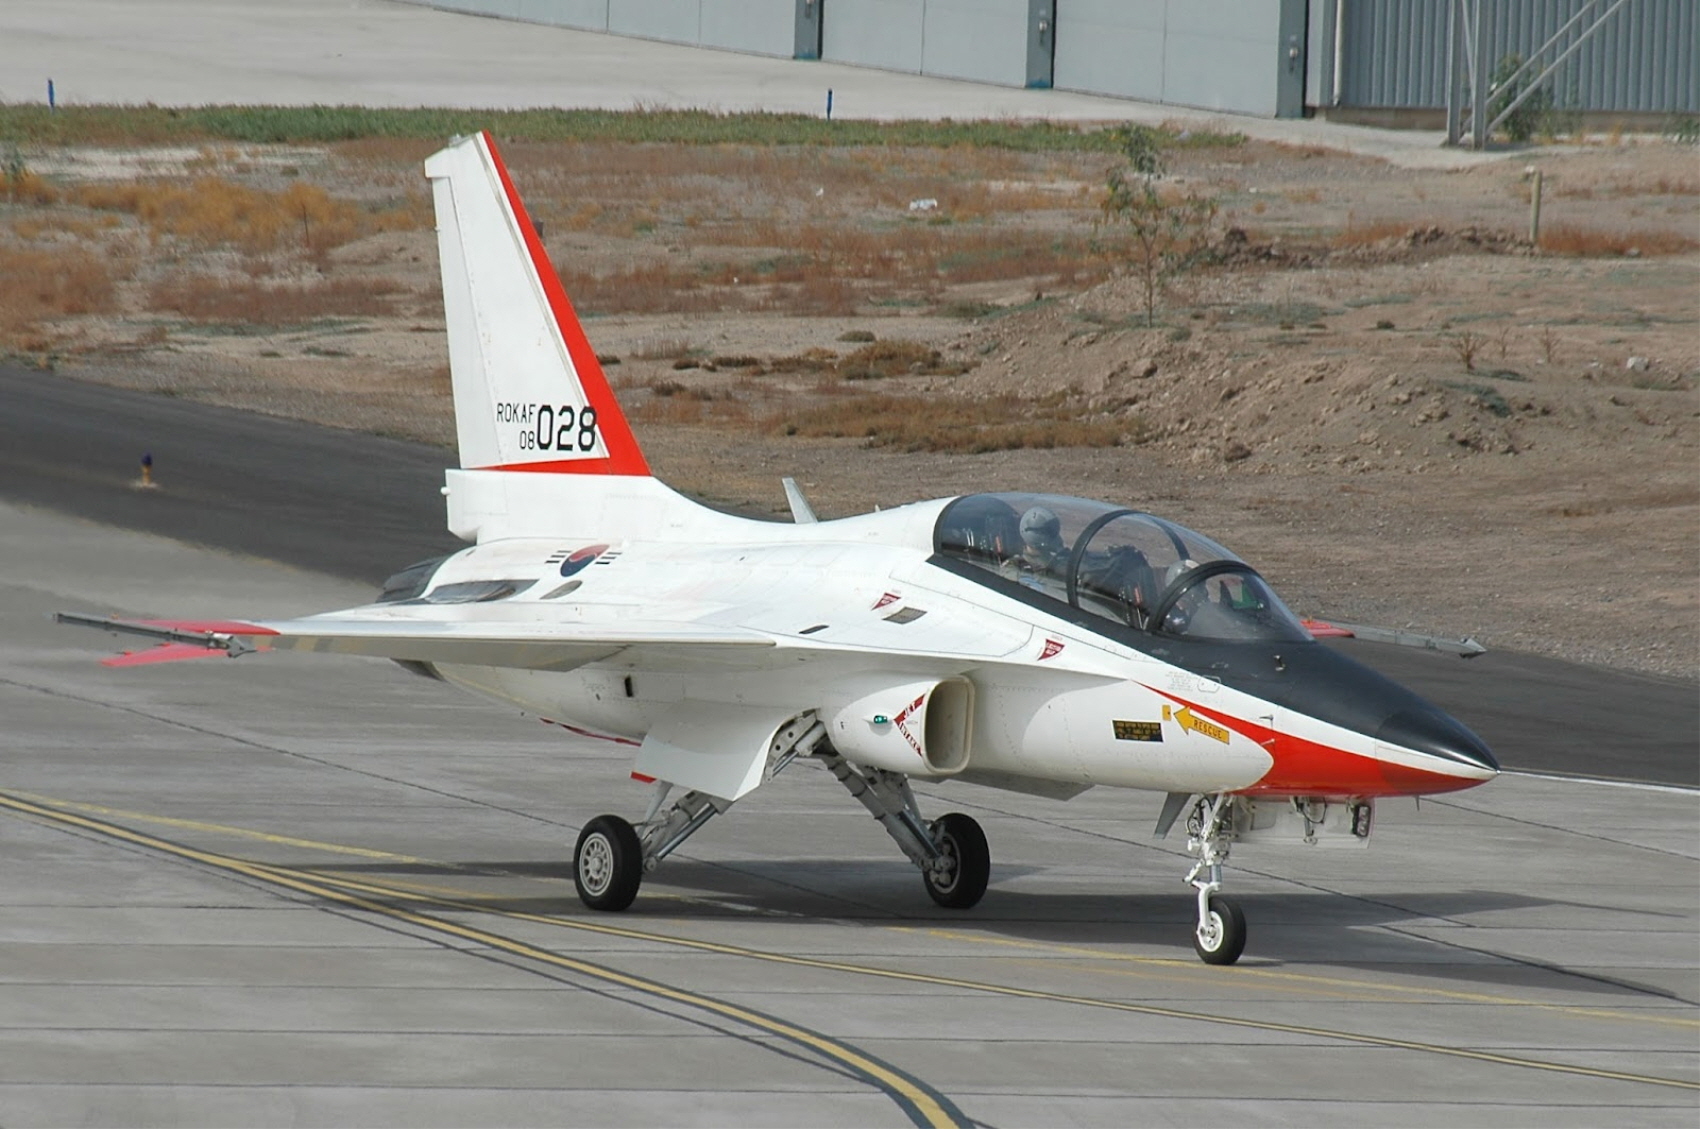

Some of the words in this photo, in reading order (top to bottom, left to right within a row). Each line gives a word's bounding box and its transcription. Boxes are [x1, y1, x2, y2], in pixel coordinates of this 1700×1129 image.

[497, 403, 536, 423] ROKAF
[537, 405, 597, 451] 028
[519, 430, 535, 450] 08
[1193, 719, 1222, 739] RESCUE
